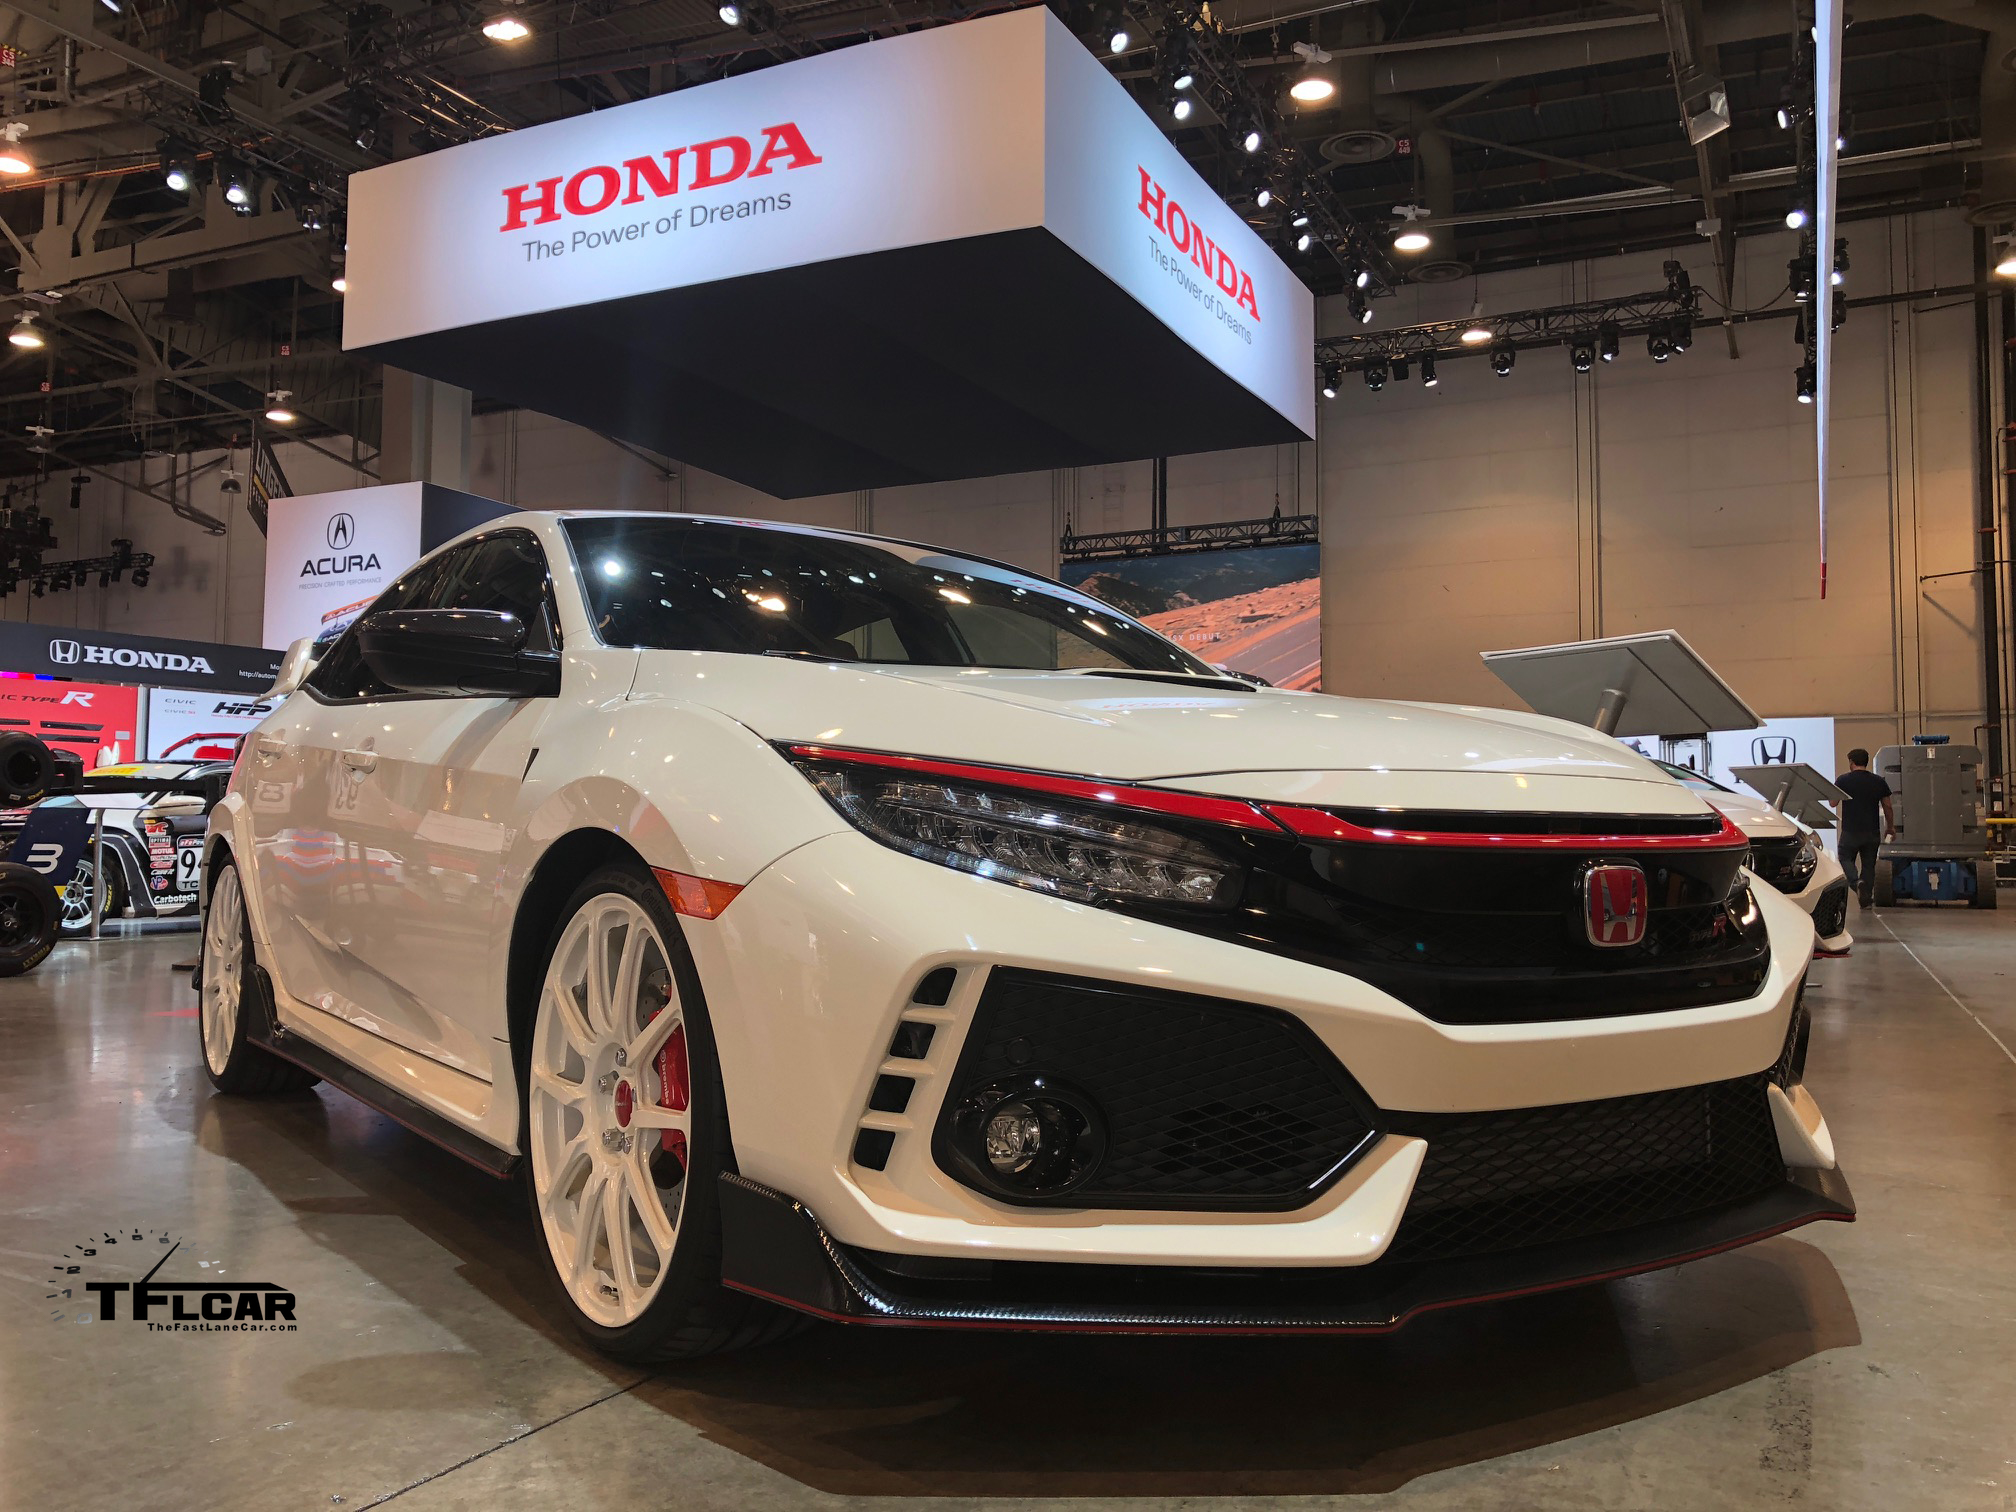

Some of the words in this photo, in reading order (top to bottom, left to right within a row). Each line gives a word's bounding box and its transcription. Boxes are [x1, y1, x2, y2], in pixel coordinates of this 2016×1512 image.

[500, 121, 823, 233] HONDA
[522, 239, 565, 262] The
[571, 219, 650, 252] Power
[655, 208, 683, 234] of
[689, 192, 792, 227] Dreams
[1137, 164, 1261, 322] HONDA
[1149, 235, 1169, 271] The
[1170, 256, 1203, 302] Power
[1204, 294, 1215, 313] of
[1216, 301, 1252, 345] Dreams
[300, 553, 382, 577] ACURA
[299, 582, 323, 590] PRECISION
[324, 580, 345, 588] CRAFTED
[346, 577, 382, 586] PERFORMANCE
[1190, 632, 1220, 641] DEBUT
[84, 645, 215, 674] HONDA
[239, 669, 278, 680] http://autom
[21, 695, 59, 703] TYPE
[60, 690, 95, 708] R
[212, 701, 273, 716] HFP
[181, 849, 202, 879] 9
[154, 893, 197, 904] Carbotech
[661, 1063, 670, 1105] brembo
